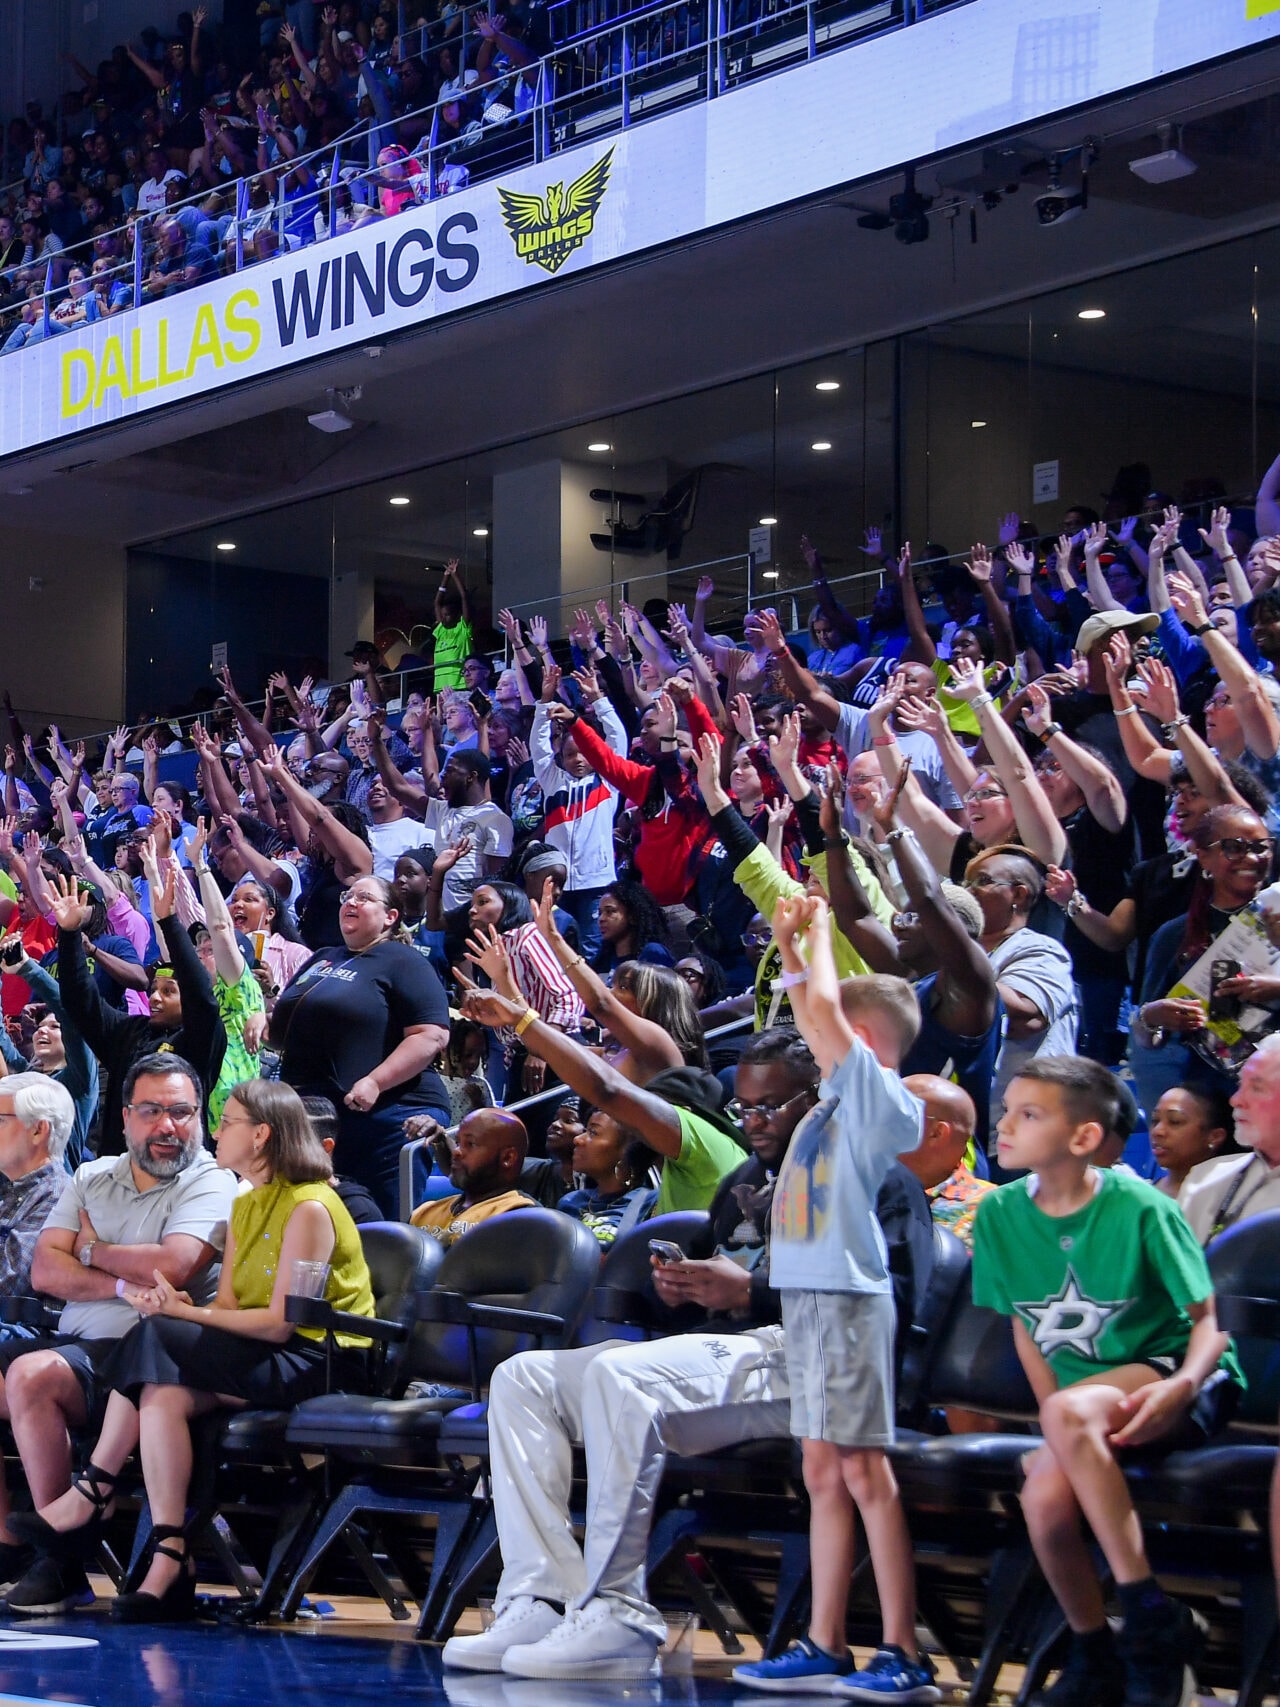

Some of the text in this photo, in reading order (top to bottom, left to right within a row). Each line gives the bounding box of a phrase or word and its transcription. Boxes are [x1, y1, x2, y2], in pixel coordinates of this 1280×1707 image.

[526, 237, 581, 261] DALLAS
[59, 211, 479, 419] DALLAS WINGS
